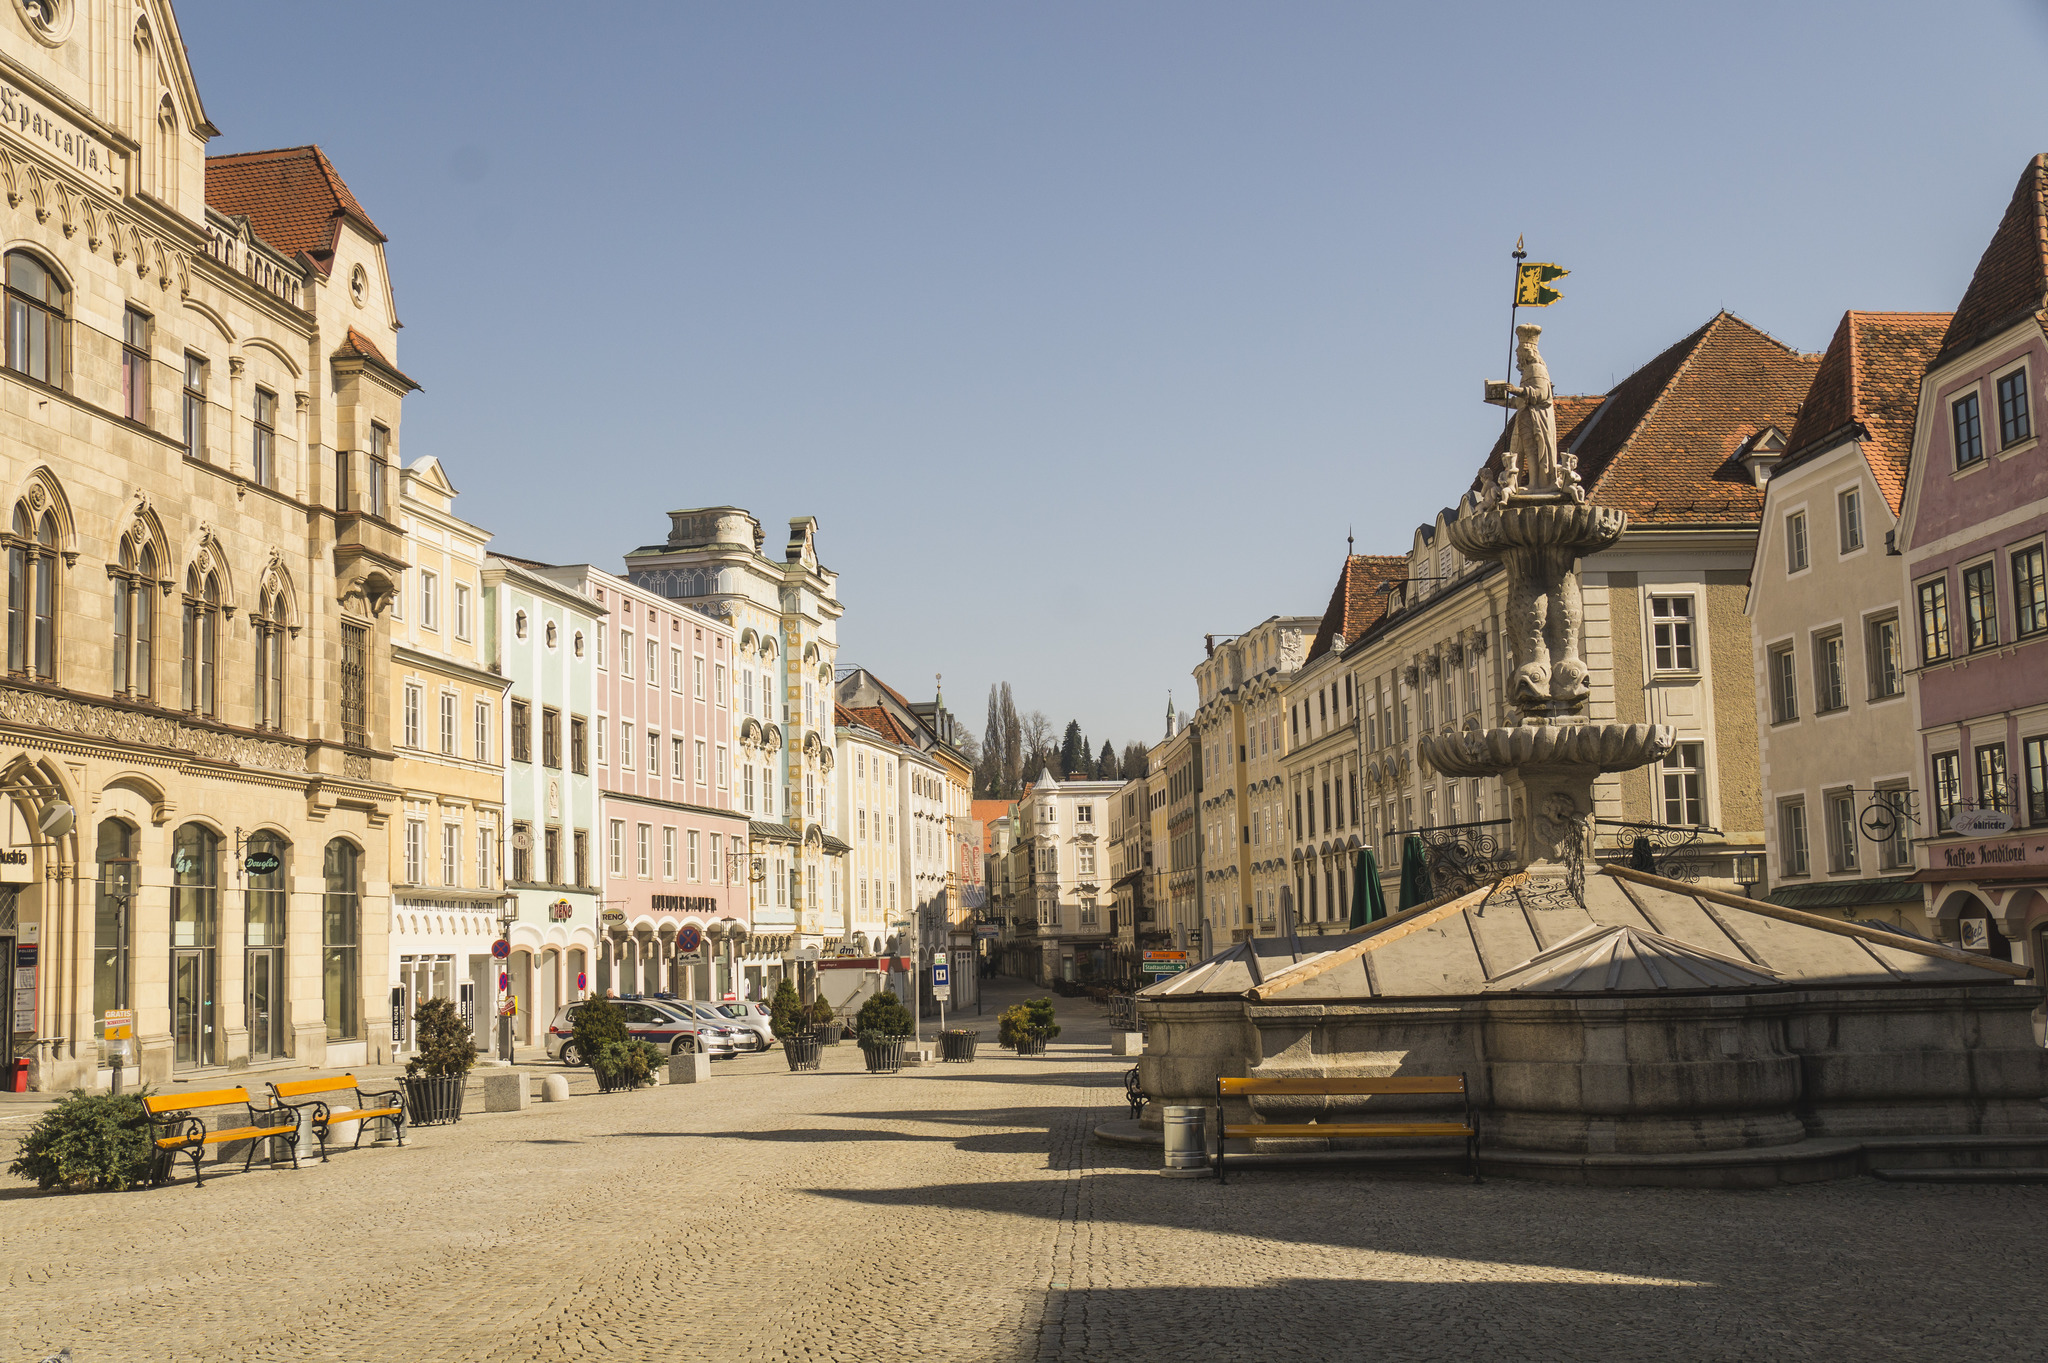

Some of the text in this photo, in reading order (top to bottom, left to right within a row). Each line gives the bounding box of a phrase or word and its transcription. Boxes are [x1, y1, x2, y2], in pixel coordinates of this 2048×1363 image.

[1944, 843, 2026, 867] Kaffee Konditorei
[246, 858, 278, 870] Douglas
[554, 904, 572, 918] RENO
[840, 946, 854, 954] dm
